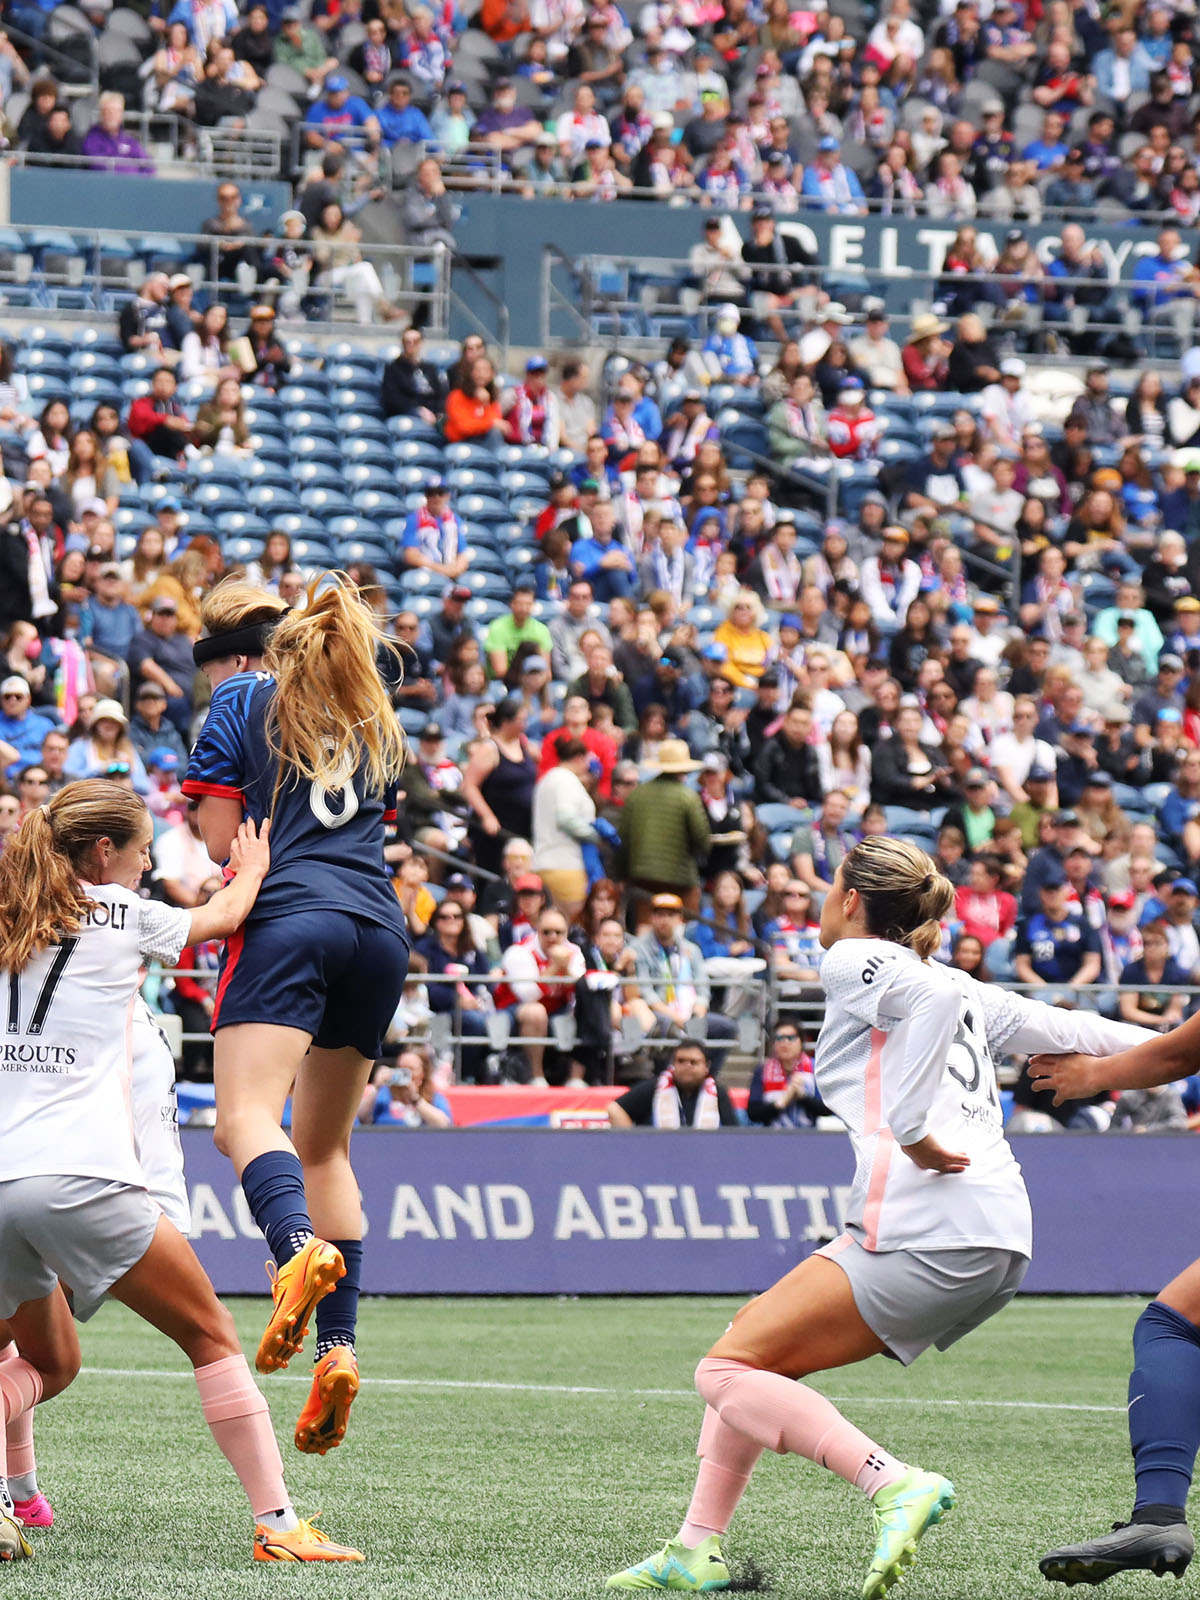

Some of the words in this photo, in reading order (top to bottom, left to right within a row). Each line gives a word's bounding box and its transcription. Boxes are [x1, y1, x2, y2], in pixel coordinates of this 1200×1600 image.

[6, 933, 81, 1036] 17
[29, 1063, 71, 1075] MARKET
[387, 1183, 535, 1240] AND
